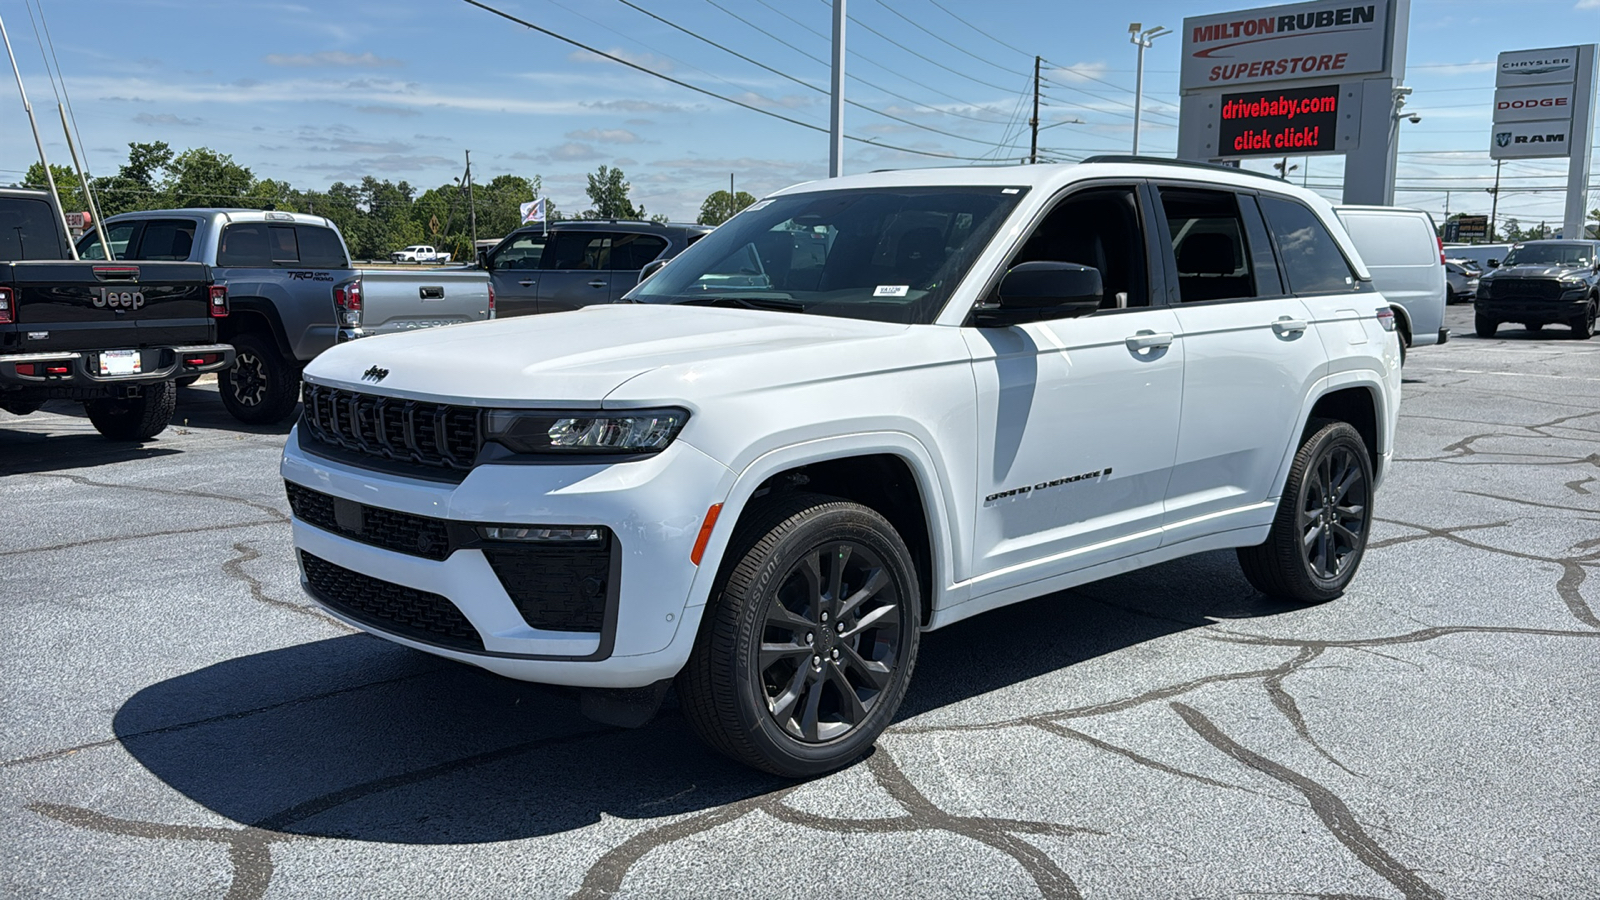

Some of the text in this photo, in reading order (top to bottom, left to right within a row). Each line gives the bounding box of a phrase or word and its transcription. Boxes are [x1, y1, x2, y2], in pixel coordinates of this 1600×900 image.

[1193, 5, 1374, 42] MILTON RUBEN
[1208, 53, 1348, 81] SUPERSTORE
[1502, 59, 1569, 68] CHRYSLER
[1222, 95, 1336, 120] drivebaby.com
[1497, 97, 1568, 110] DODGE
[1233, 125, 1319, 150] click click!
[1514, 133, 1565, 144] RAM
[287, 271, 314, 281] TRD
[92, 287, 145, 310] Jeep
[985, 470, 1101, 501] GRAND CHEROKEE
[739, 553, 780, 668] BRIDGESTONE
